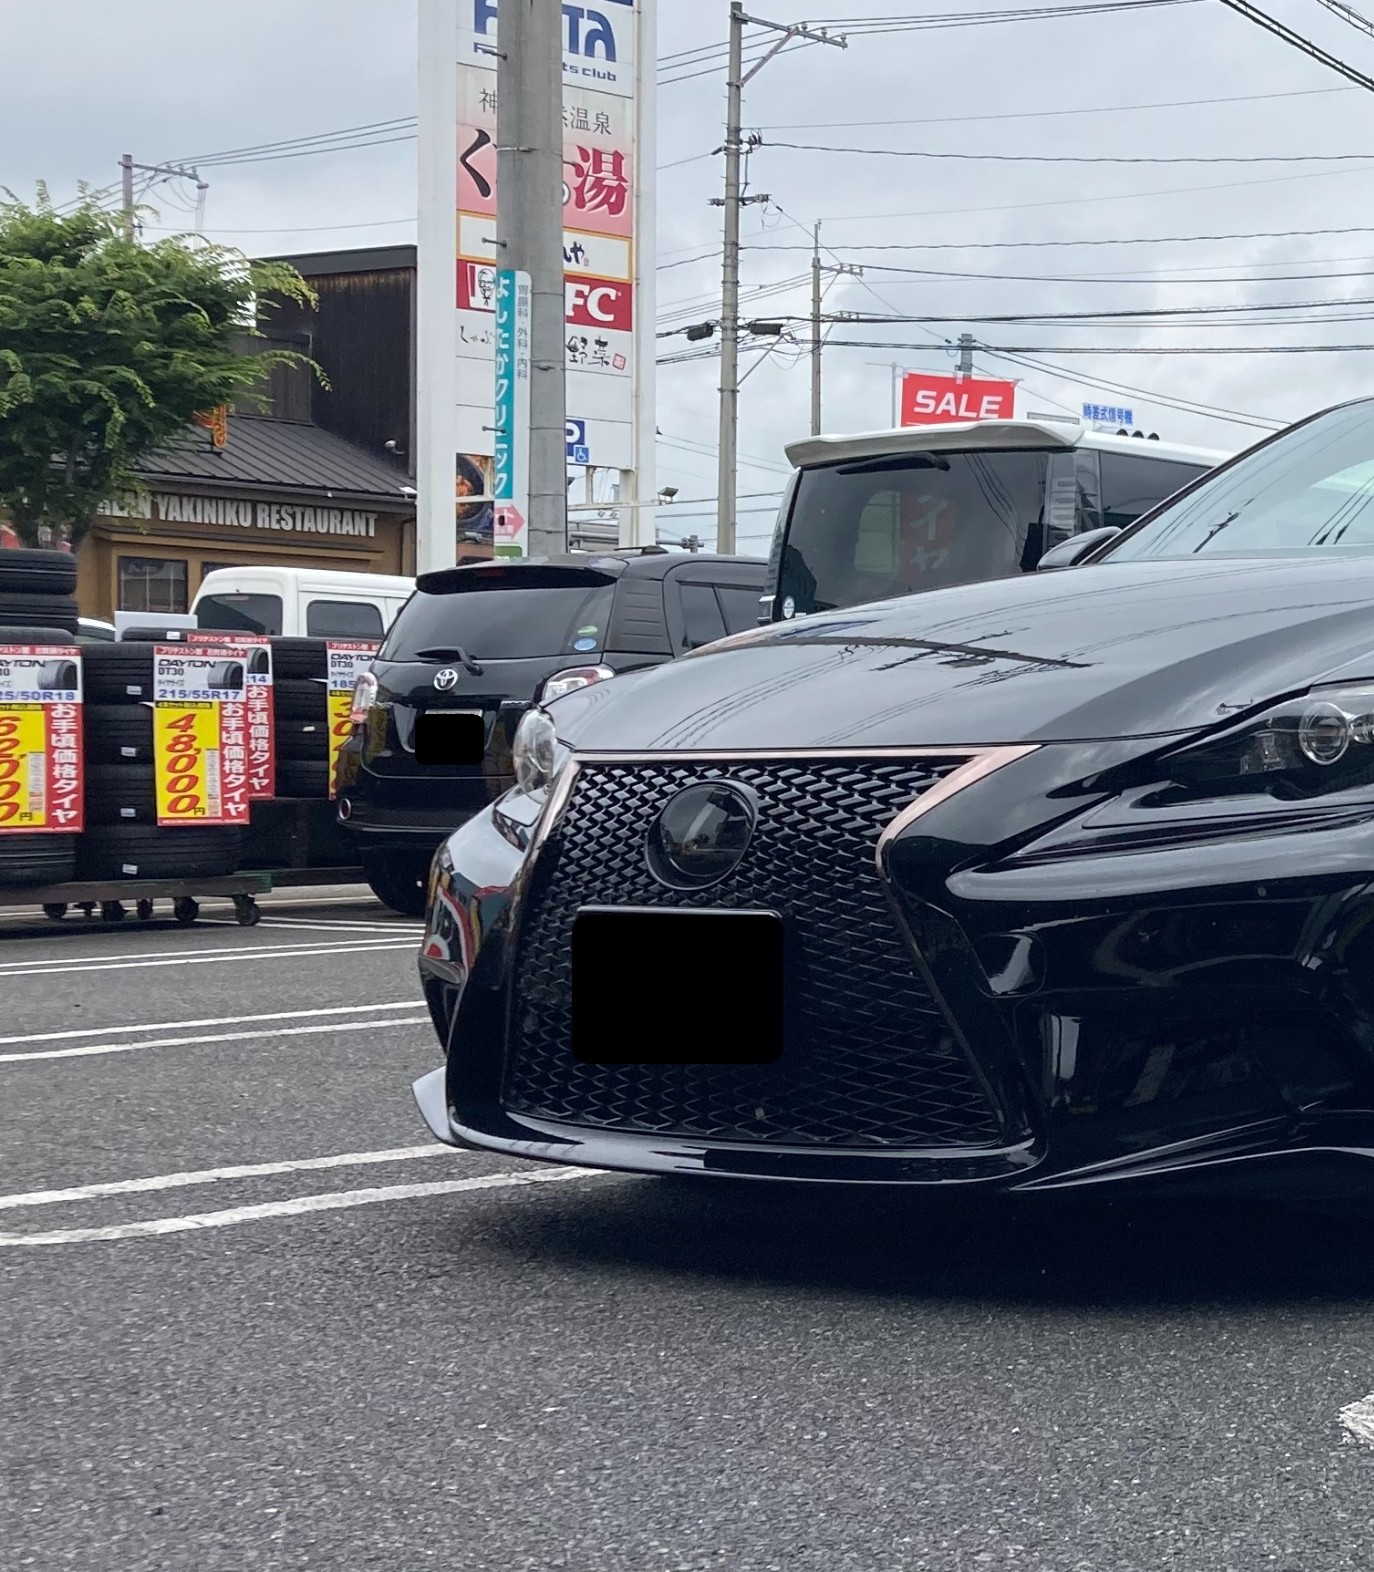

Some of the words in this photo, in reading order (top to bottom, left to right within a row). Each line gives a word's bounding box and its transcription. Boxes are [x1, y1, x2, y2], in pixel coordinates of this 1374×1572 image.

[582, 66, 617, 82] club
[913, 390, 1003, 419] SALE
[1083, 404, 1133, 425] 時差式信号機
[156, 495, 251, 528] YAKINIKU
[256, 502, 378, 537] RESTAURANT
[910, 494, 949, 572] イヤ
[158, 659, 216, 668] DAYTON
[158, 667, 184, 676] DT30
[159, 689, 240, 700] 215/55R17
[247, 686, 270, 791] お手頃価格タイヤ
[50, 703, 79, 824] お手頃価格タイヤ
[222, 702, 247, 817] お手頃価格タイヤ
